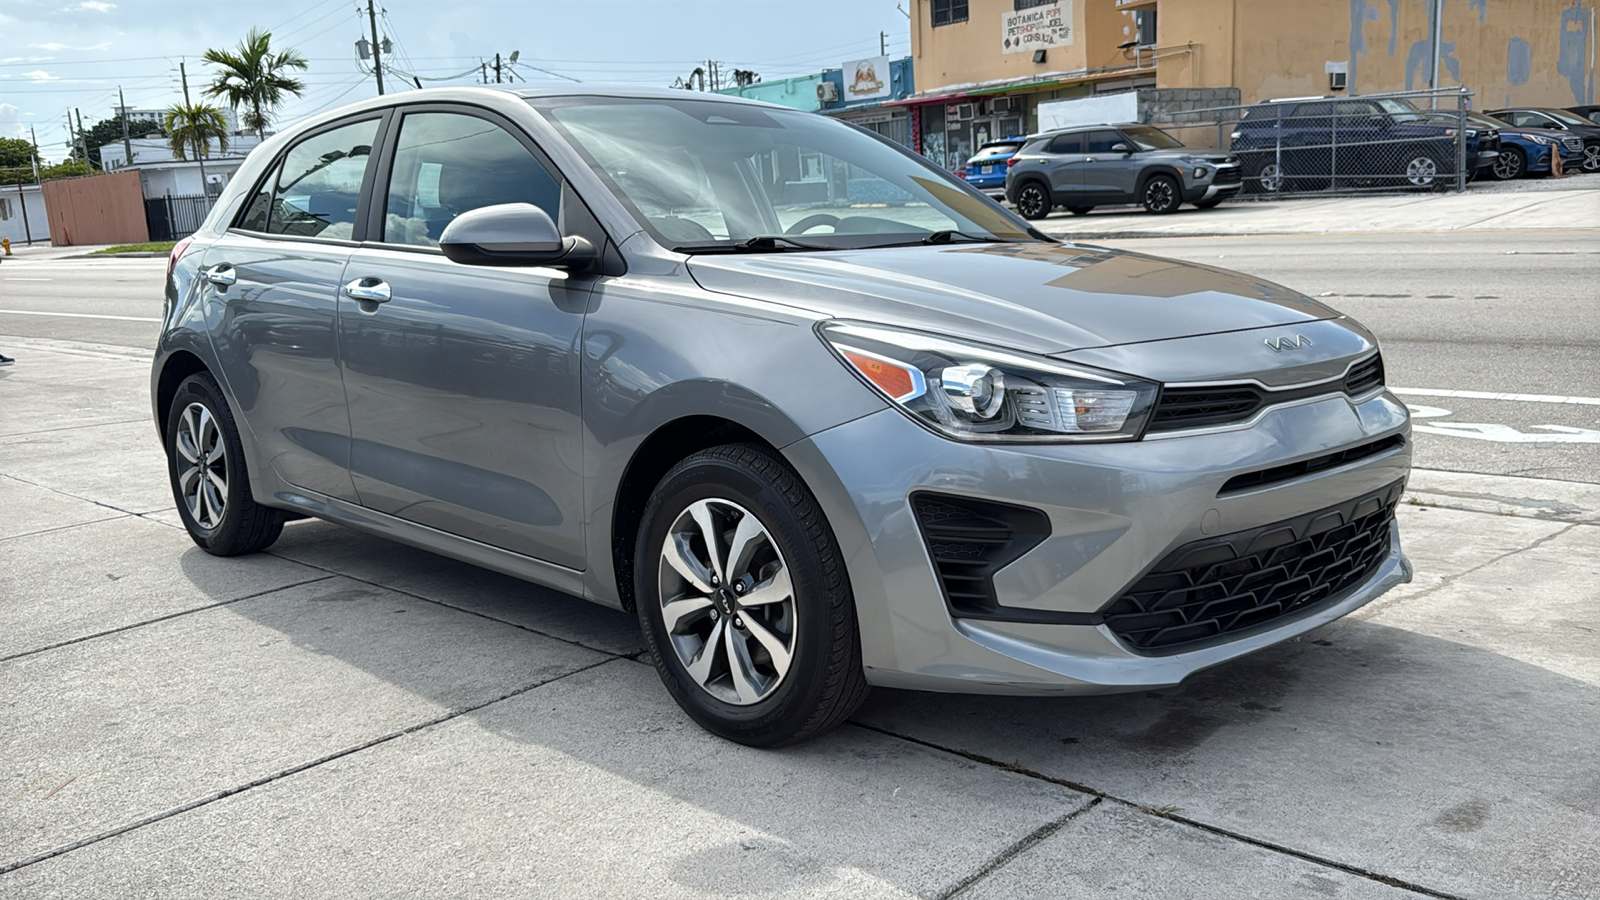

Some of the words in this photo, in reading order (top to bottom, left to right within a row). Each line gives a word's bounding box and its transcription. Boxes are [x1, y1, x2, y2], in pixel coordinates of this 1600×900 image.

[1008, 12, 1044, 26] BOTANICA
[1046, 18, 1063, 28] JOEL
[1264, 334, 1313, 353] KIA
